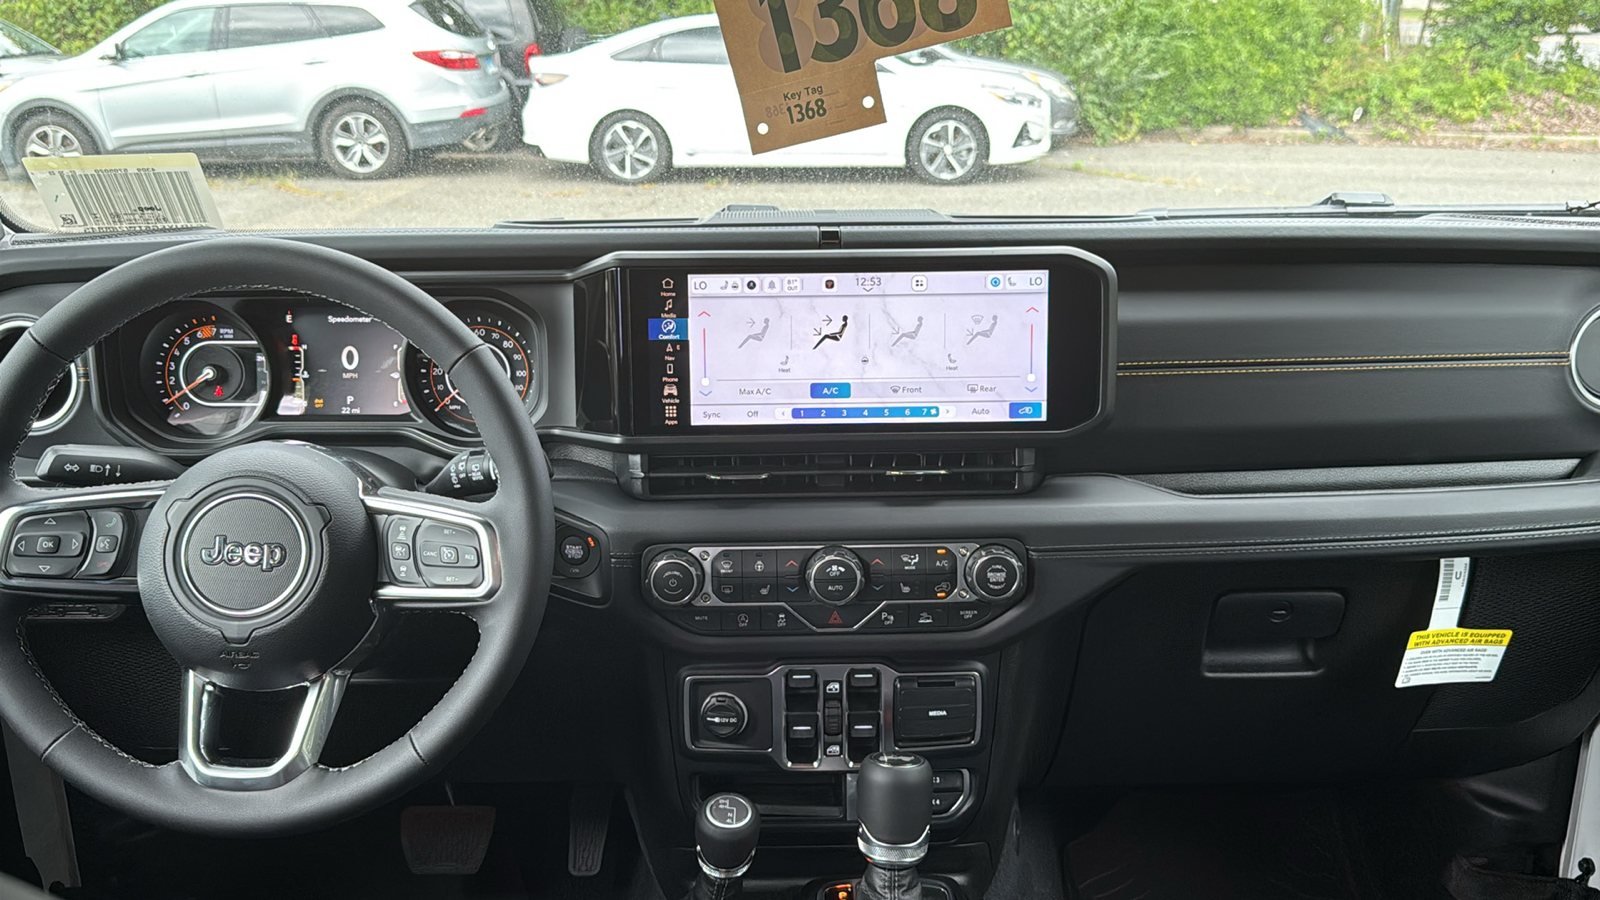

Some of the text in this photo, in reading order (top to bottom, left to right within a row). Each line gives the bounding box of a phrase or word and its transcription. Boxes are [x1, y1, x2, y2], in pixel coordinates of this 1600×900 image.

[783, 86, 802, 101] Key
[804, 85, 824, 96] Tag
[786, 98, 827, 124] 1368
[856, 277, 882, 286] 12:53
[1029, 277, 1042, 286] LO
[694, 282, 707, 290] LO
[328, 316, 372, 324] Speedometer
[211, 328, 216, 336] 7
[184, 337, 190, 345] 5
[341, 345, 359, 370] 0
[169, 362, 175, 370] 3
[433, 368, 443, 376] 20
[169, 376, 175, 385] 2
[346, 396, 354, 404] P
[200, 534, 287, 572] Jeep
[838, 892, 847, 900] P
